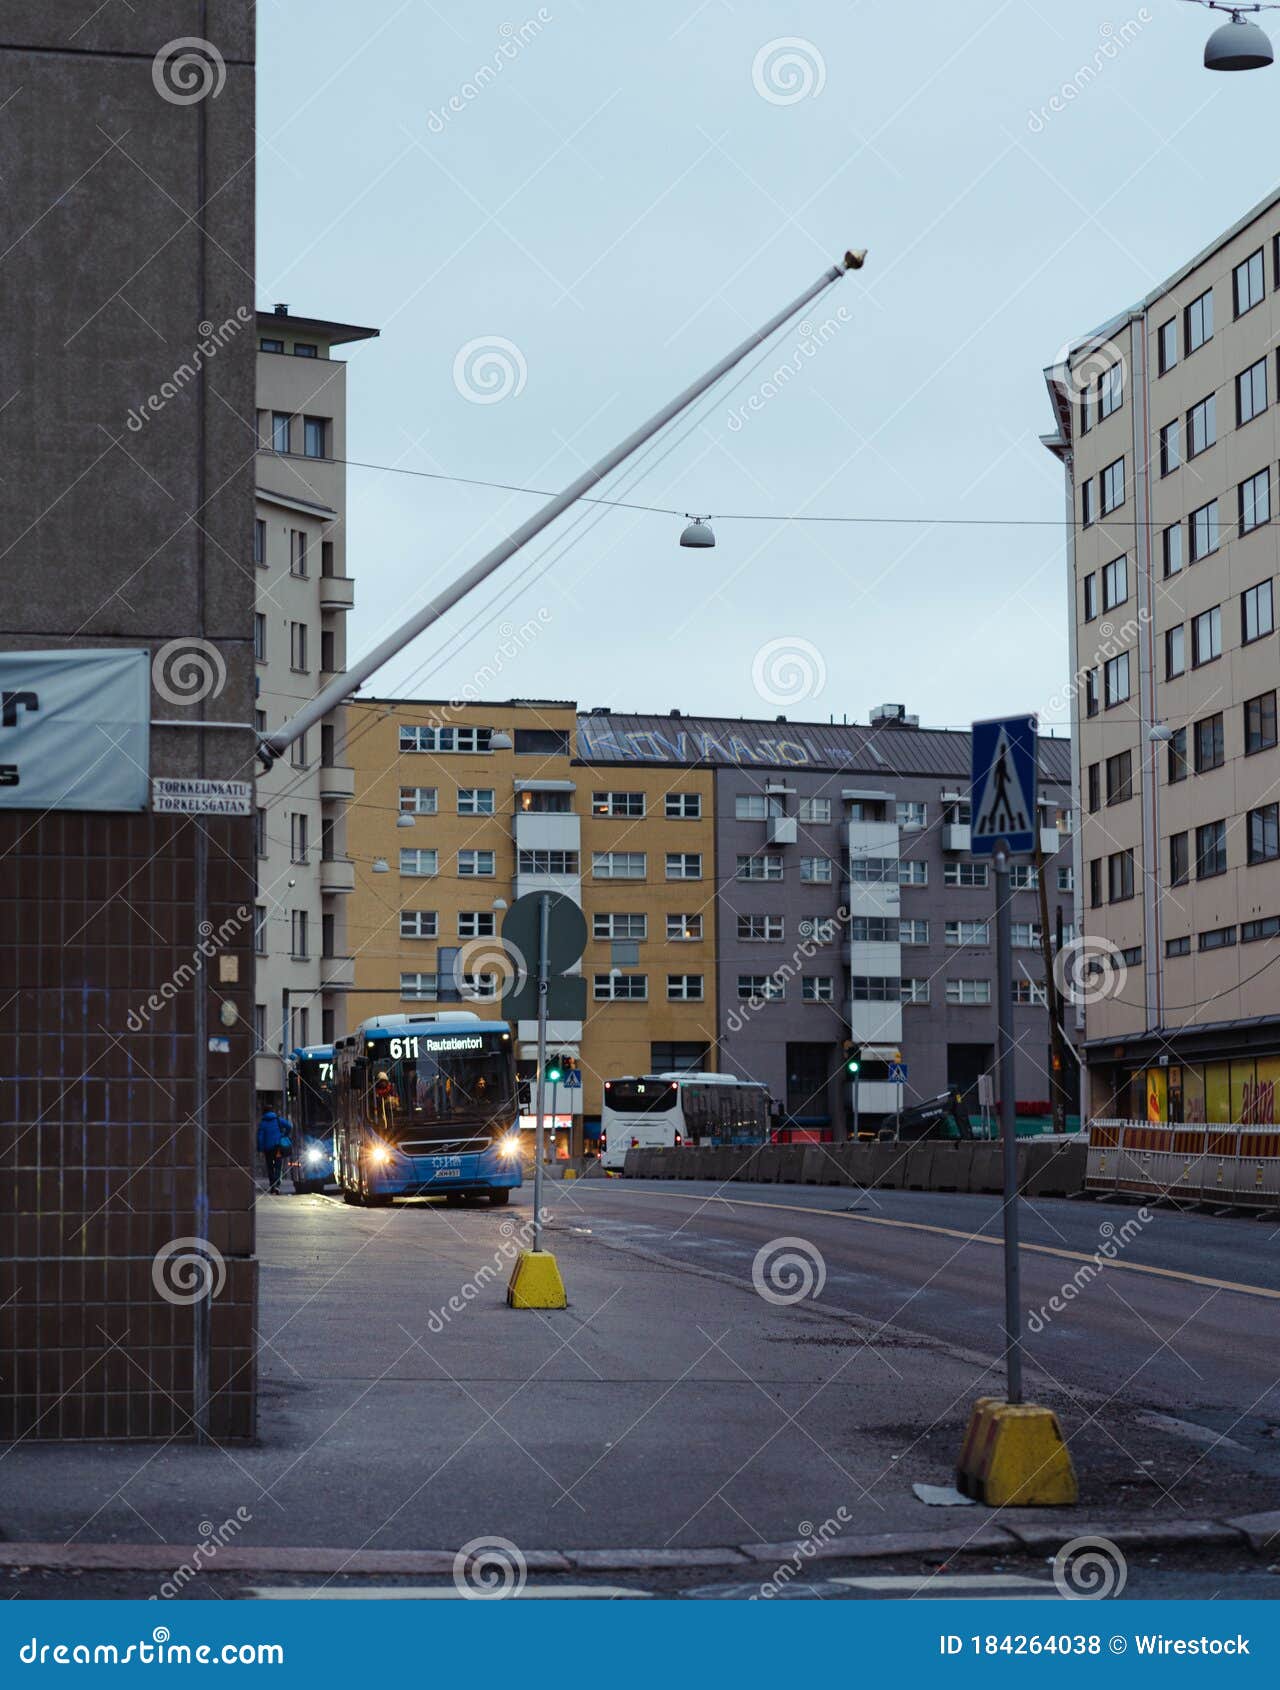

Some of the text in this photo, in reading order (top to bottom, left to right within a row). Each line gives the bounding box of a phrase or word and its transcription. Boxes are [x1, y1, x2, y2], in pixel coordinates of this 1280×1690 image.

[159, 781, 247, 796] TORKKELINKATU
[159, 798, 246, 813] TORKELSGATAN
[389, 1036, 483, 1059] 611 Rautatientori
